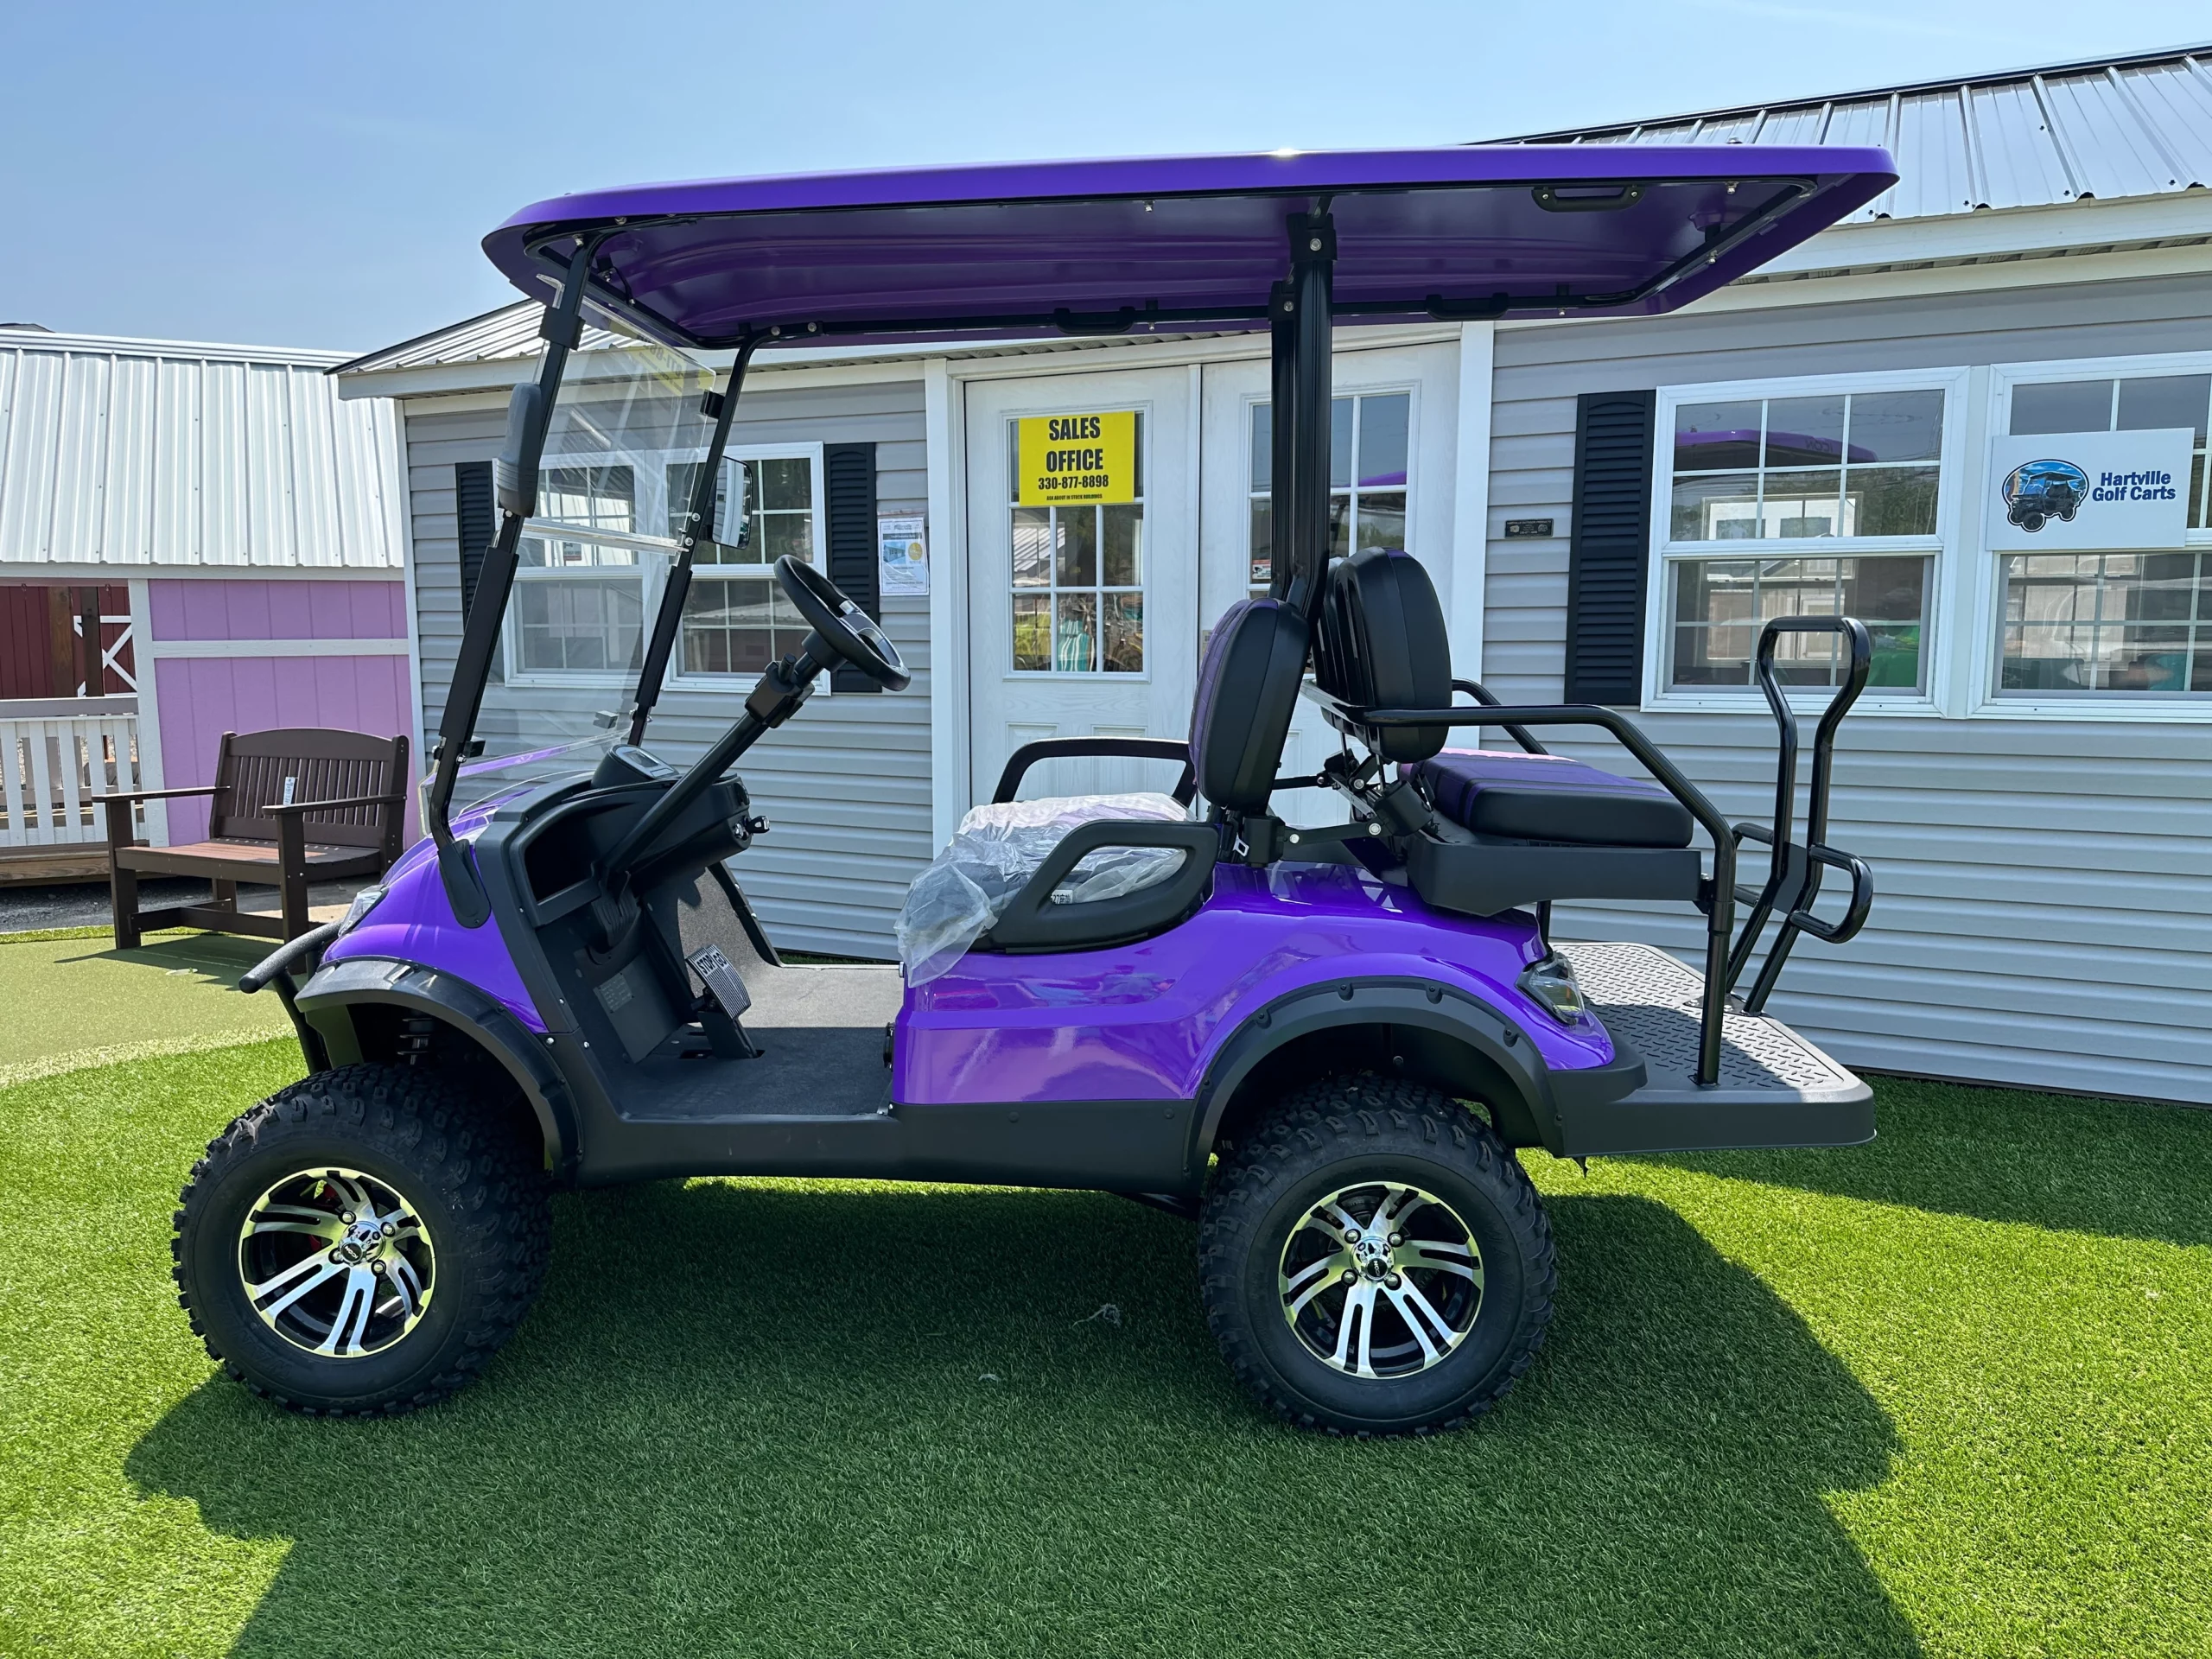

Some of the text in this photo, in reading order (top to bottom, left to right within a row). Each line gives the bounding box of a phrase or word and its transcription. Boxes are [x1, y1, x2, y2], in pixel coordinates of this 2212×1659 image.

[1048, 416, 1101, 441] SALES
[1046, 448, 1103, 473] OFFICE
[1038, 474, 1109, 490] 330-877-8898
[2100, 470, 2171, 486] Hartville
[2092, 486, 2177, 502] Golf Carts
[696, 952, 728, 975] STOP GO
[344, 1245, 359, 1260] ICON
